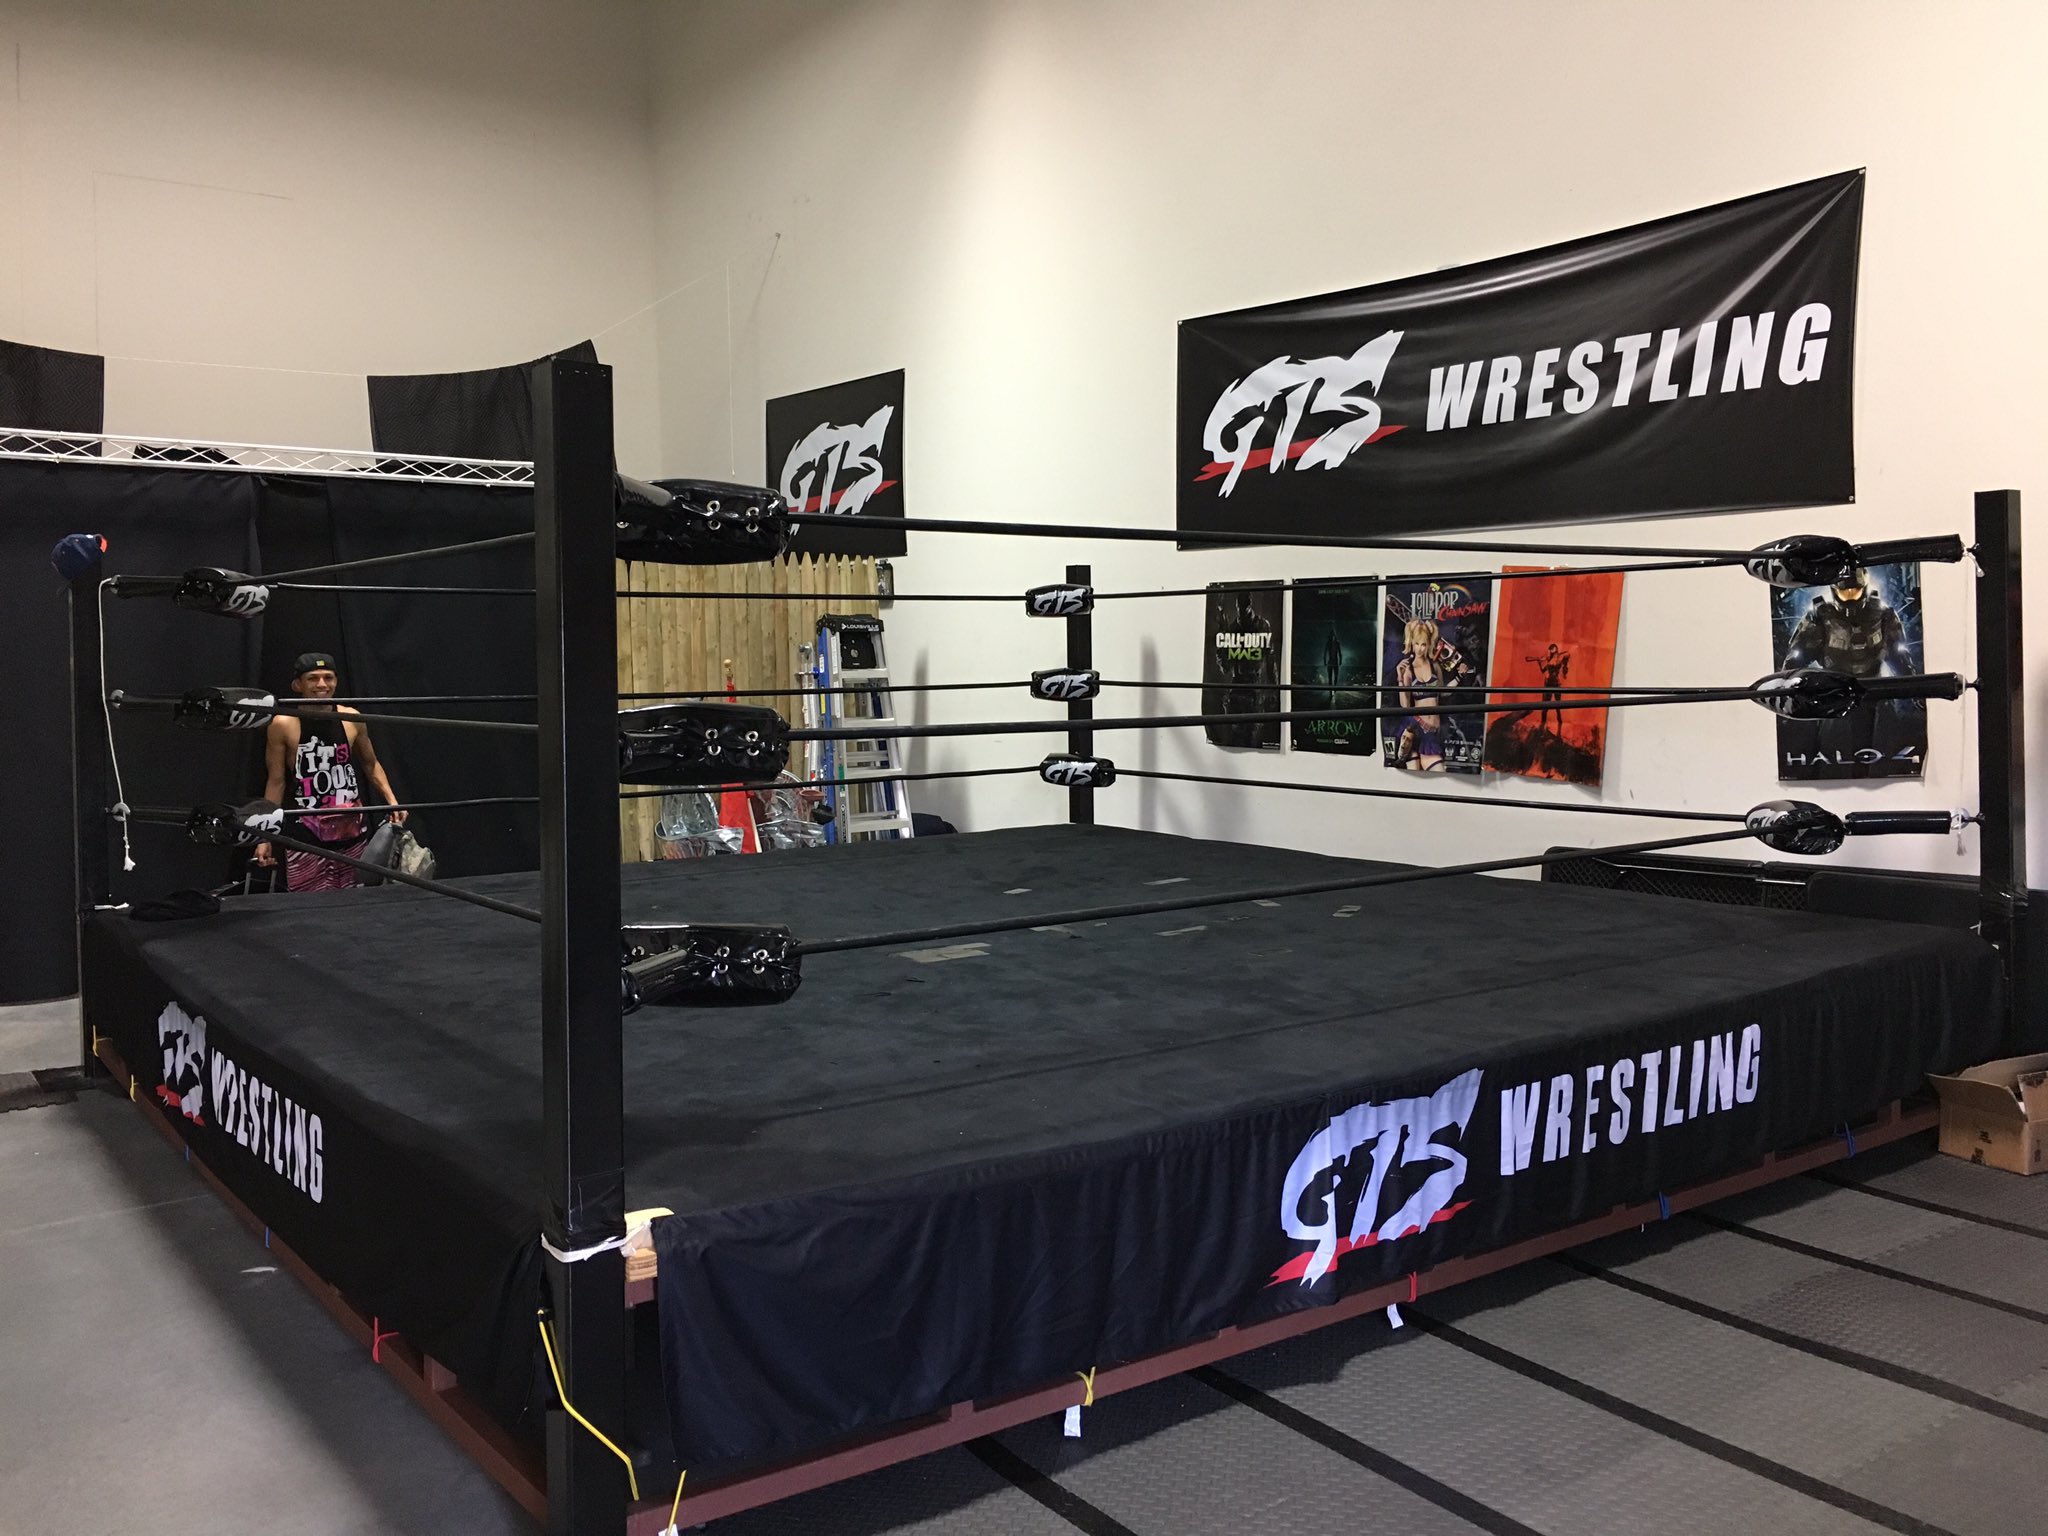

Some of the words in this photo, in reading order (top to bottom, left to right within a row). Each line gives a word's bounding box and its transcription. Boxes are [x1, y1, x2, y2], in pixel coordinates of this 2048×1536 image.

[1196, 330, 1405, 498] GTS
[1425, 302, 1833, 433] WRESTLING
[780, 404, 896, 536] GTS
[1033, 588, 1086, 615] GTS
[1228, 647, 1262, 661] MW3
[1041, 674, 1092, 698] GTS
[1304, 719, 1363, 737] ARROW
[1786, 748, 1884, 766] HALO
[1892, 746, 1921, 764] 4
[1045, 761, 1098, 787] GTS
[211, 1046, 323, 1204] WRESTLING
[1278, 1067, 1485, 1289] GTS
[1500, 1023, 1762, 1176] WRESTLING
